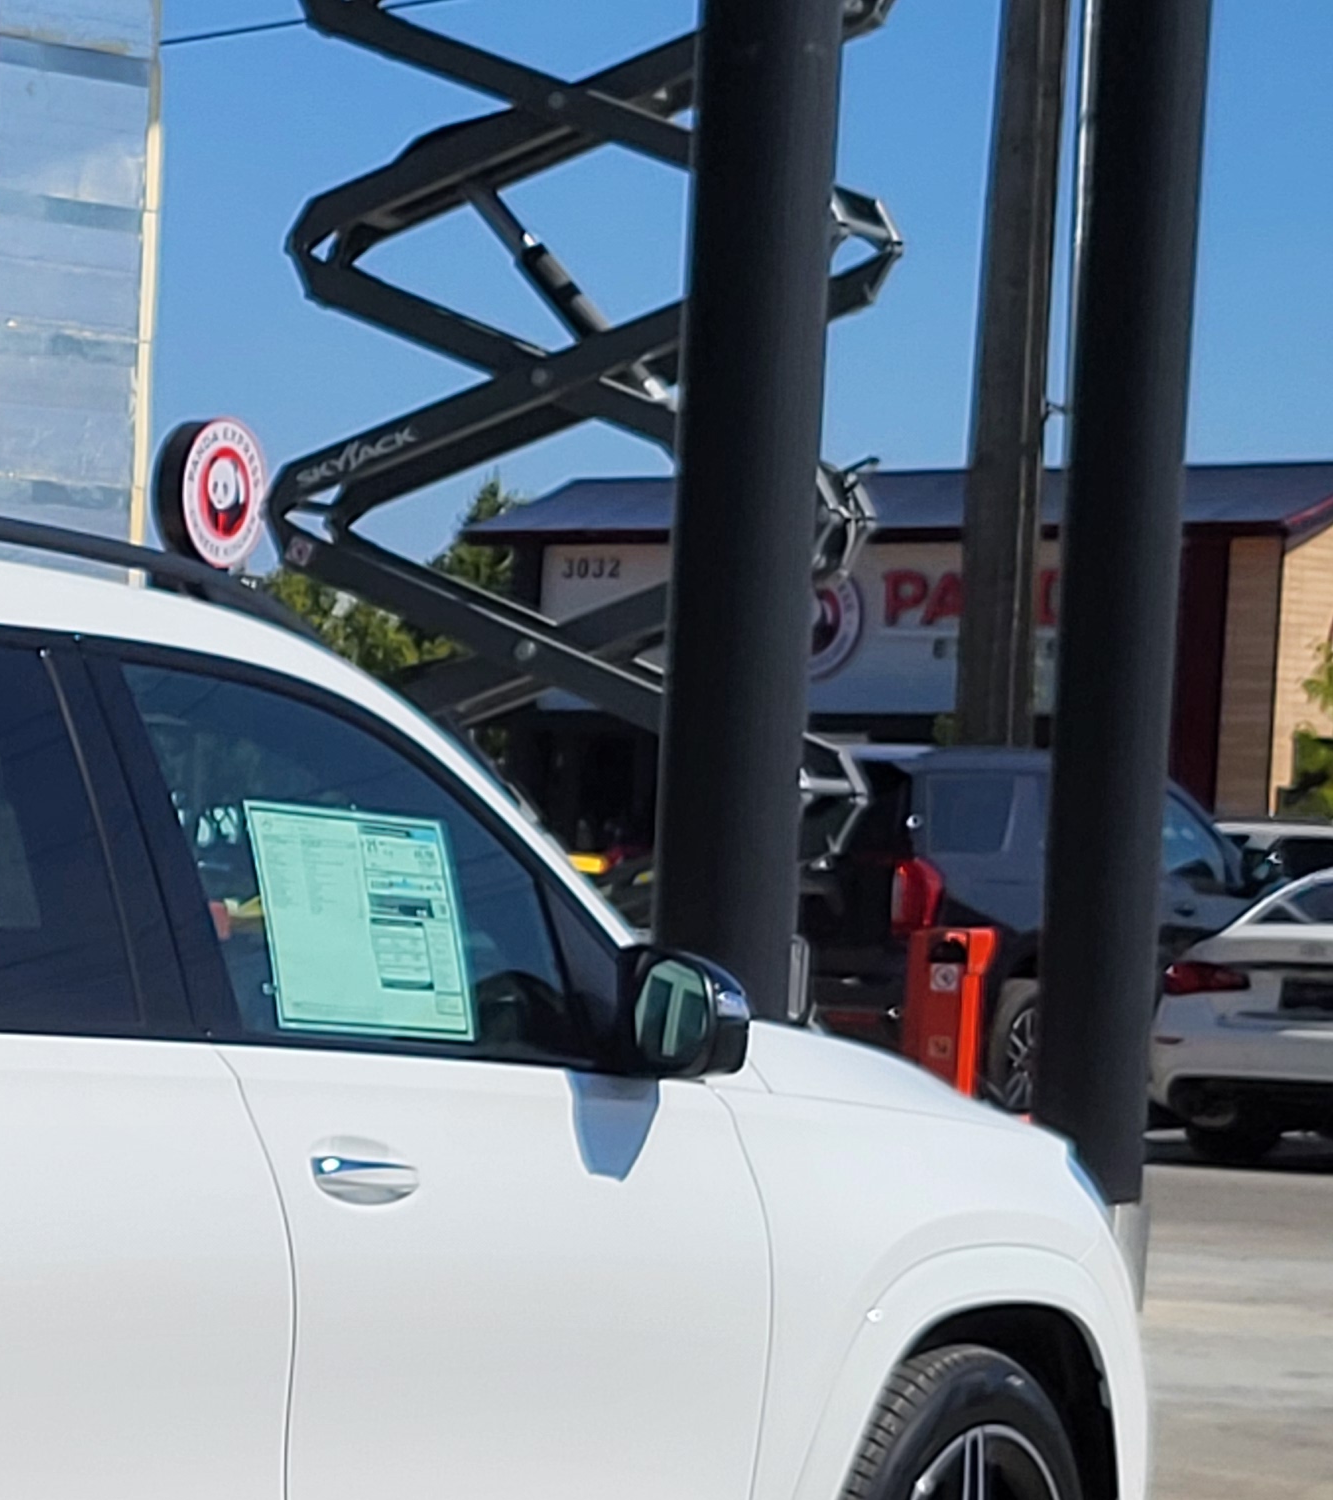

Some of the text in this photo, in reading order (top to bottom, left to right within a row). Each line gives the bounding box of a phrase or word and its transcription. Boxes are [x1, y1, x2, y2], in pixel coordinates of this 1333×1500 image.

[187, 426, 260, 488] PANDA EXPRESS
[295, 427, 418, 485] SKYJACK
[561, 556, 621, 579] 3032
